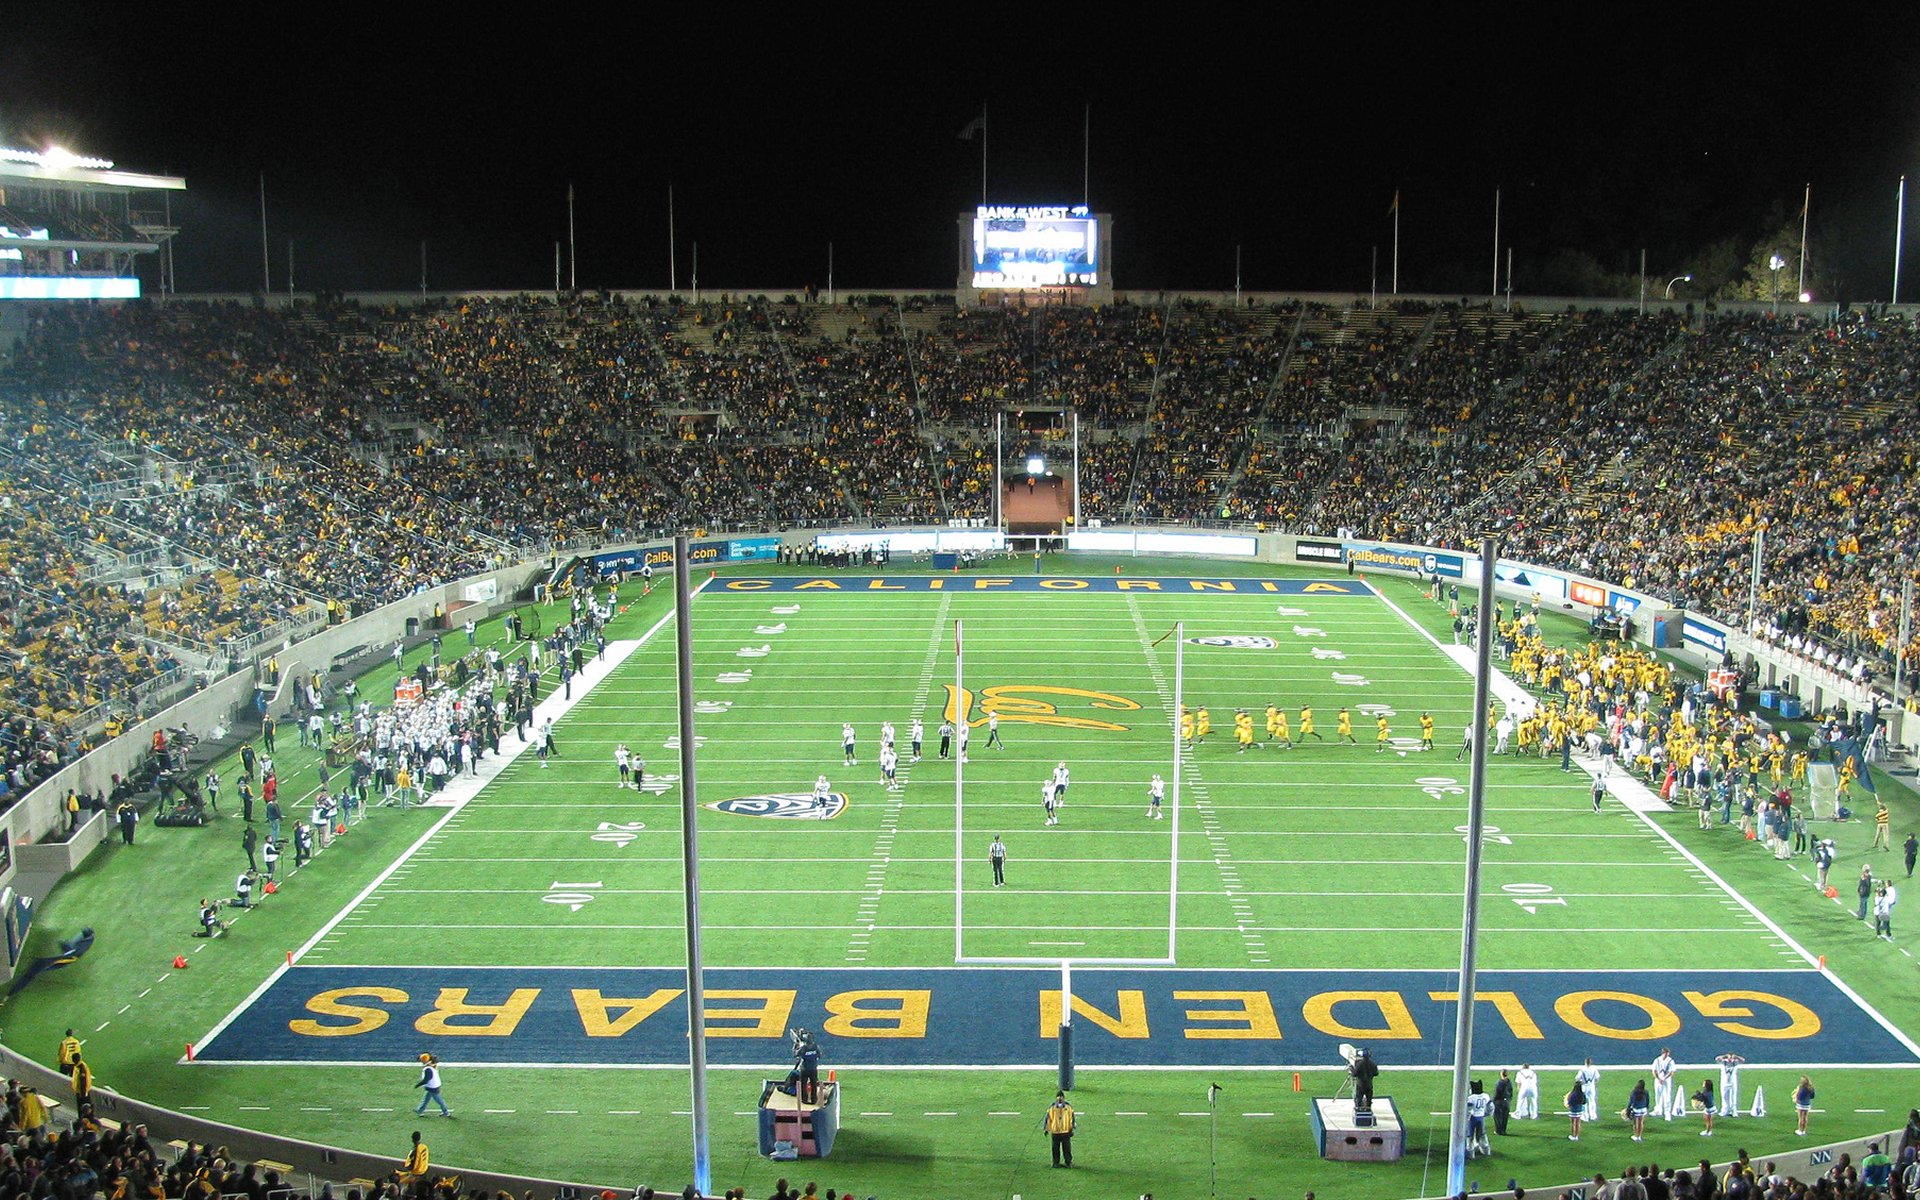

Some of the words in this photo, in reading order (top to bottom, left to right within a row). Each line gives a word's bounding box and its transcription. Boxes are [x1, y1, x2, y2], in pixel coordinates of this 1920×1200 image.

[977, 206, 1015, 219] BANK
[1028, 207, 1068, 219] WEST
[645, 548, 717, 564] CalBe.com
[1347, 549, 1421, 567] CalBears.com
[726, 579, 1350, 593] CALIFORNIA
[1414, 777, 1466, 795] 30
[590, 821, 646, 841] 20
[541, 880, 604, 904] 10
[1501, 883, 1568, 906] 10
[288, 986, 932, 1038] BEARS
[1039, 989, 1822, 1040] GOLDEN
[1811, 1149, 1832, 1165] NN
[1571, 1188, 1583, 1200] N
